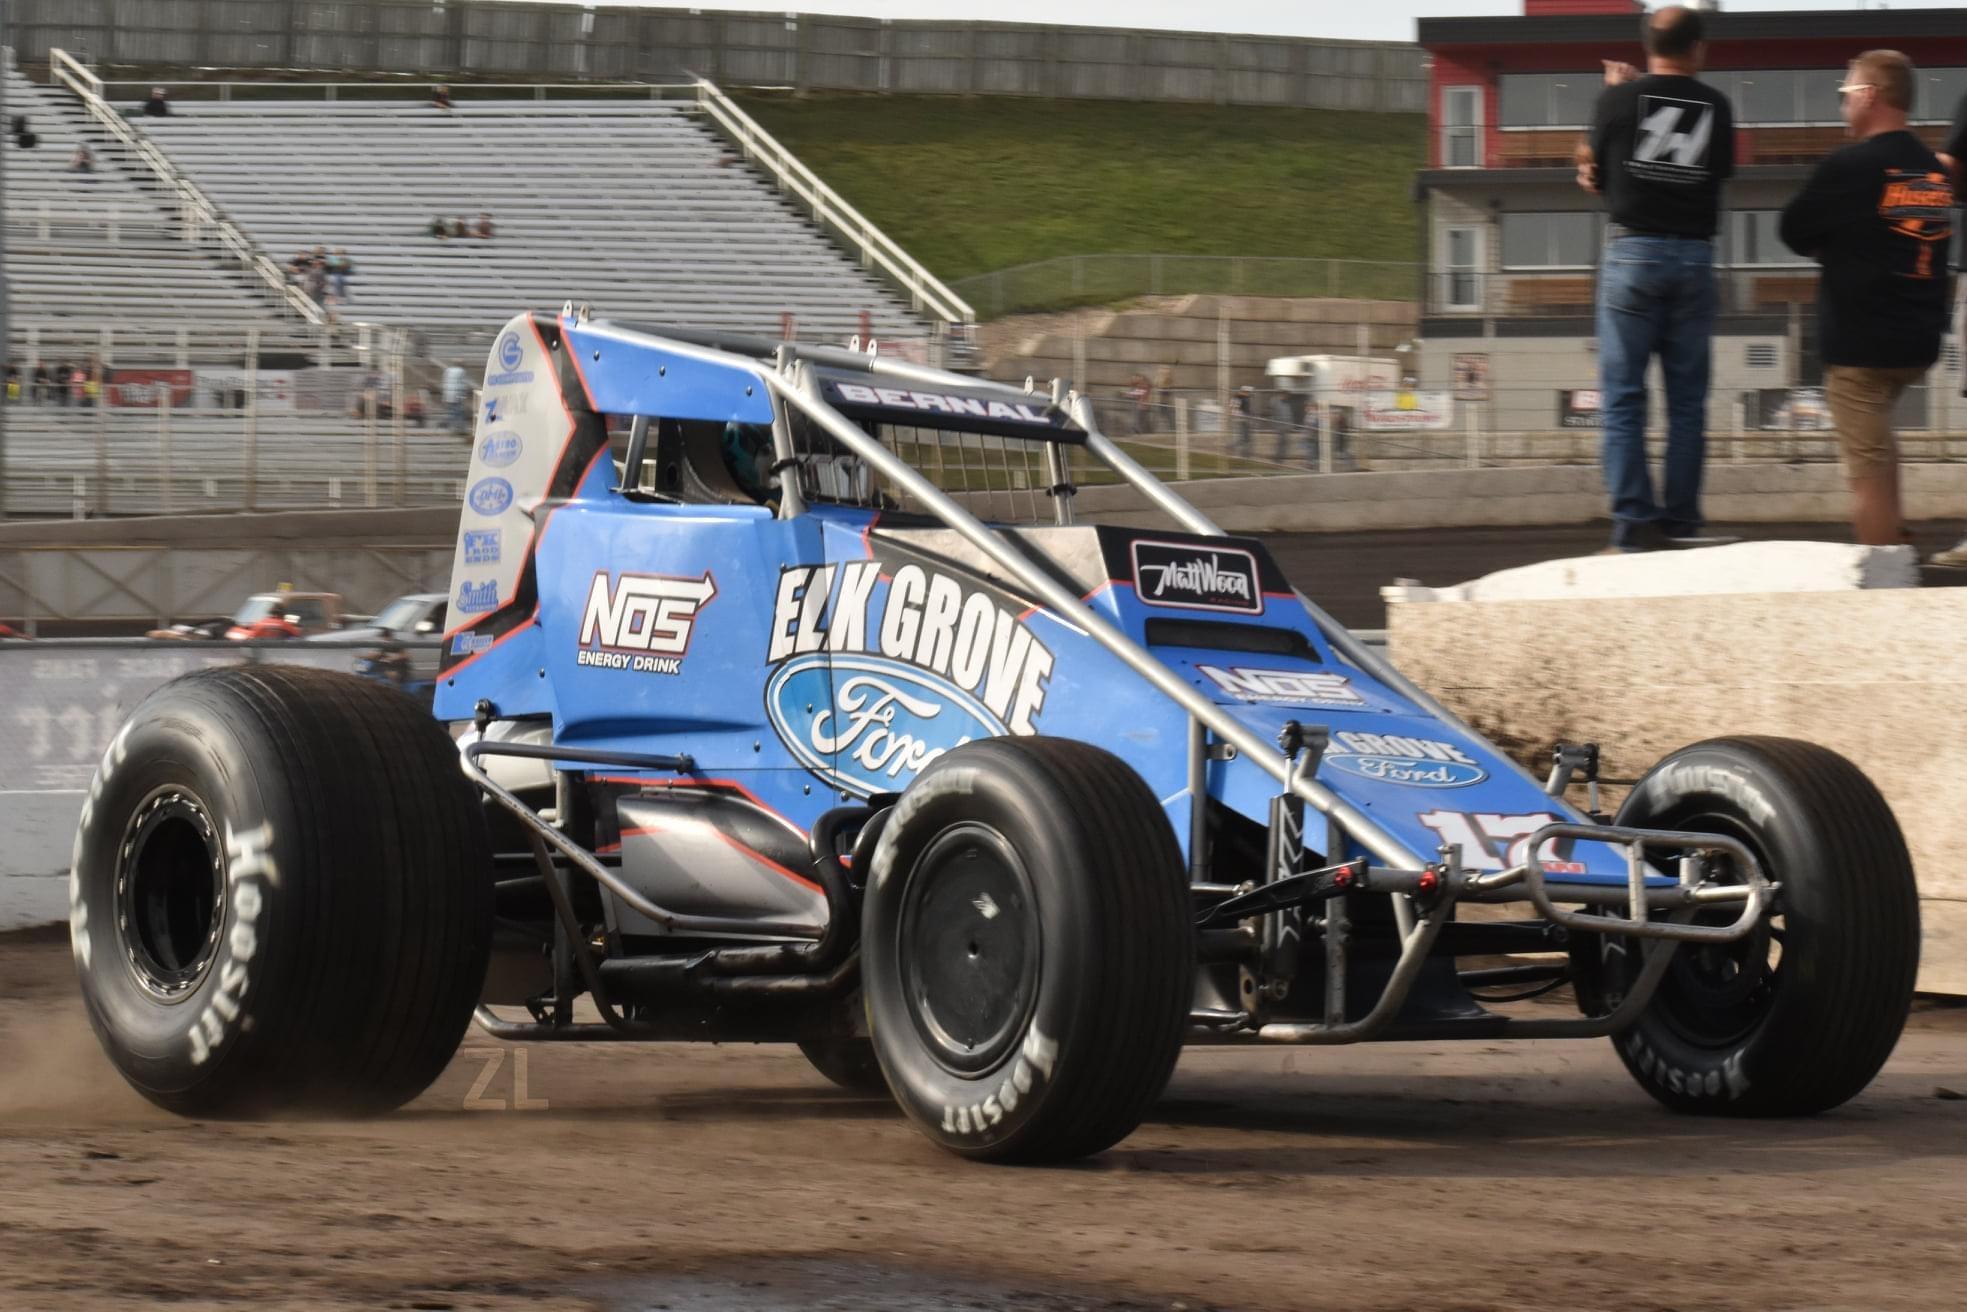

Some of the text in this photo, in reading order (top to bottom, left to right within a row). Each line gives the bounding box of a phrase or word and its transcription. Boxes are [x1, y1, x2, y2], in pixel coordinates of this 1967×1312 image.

[836, 382, 1051, 424] BERNAL
[579, 569, 718, 656] NOS
[576, 651, 681, 674] ENERGY DRINK
[766, 559, 1055, 738] ELK GROVE
[1195, 664, 1362, 702] NOS
[1335, 730, 1480, 766] GROVE
[1357, 757, 1457, 783] Ford
[1419, 809, 1568, 870] 17
